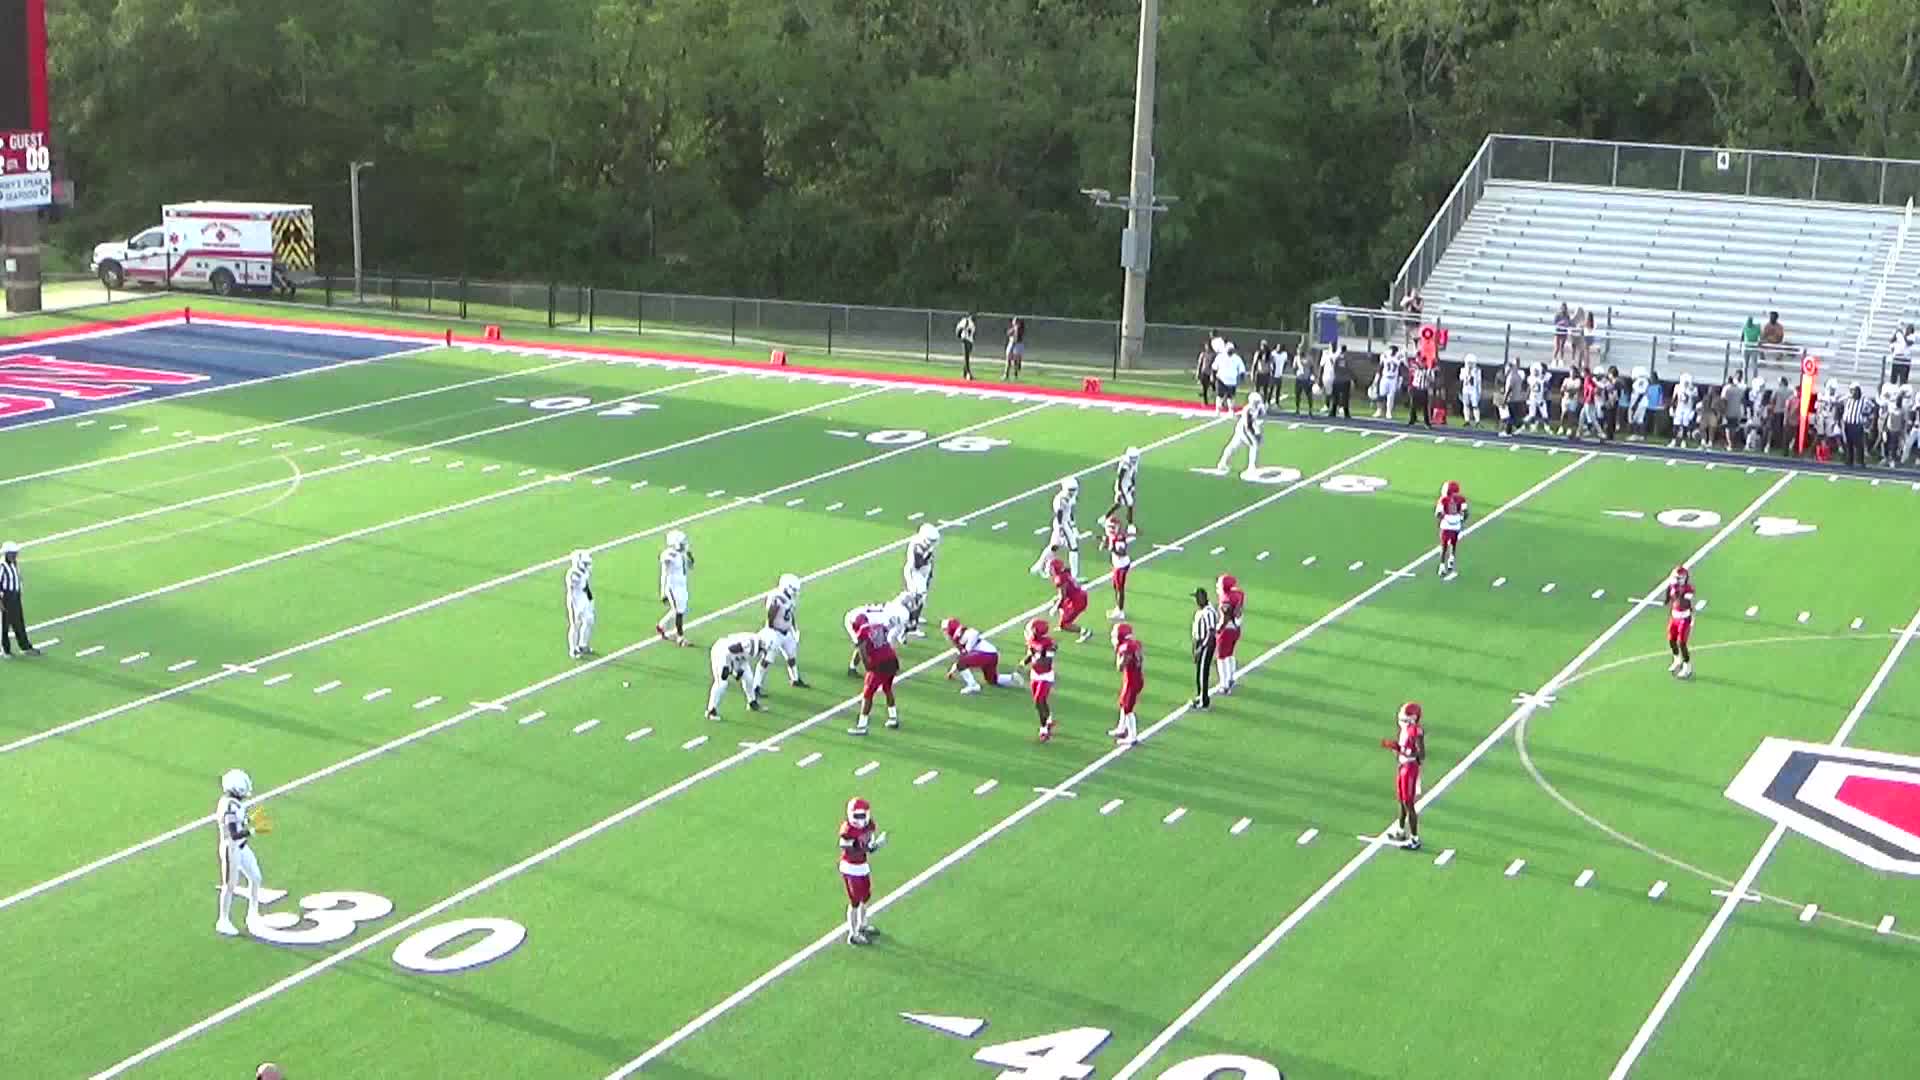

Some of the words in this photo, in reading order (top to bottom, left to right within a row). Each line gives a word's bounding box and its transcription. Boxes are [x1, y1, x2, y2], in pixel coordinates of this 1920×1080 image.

[9, 132, 44, 150] GUEST
[26, 146, 50, 172] 00
[245, 890, 528, 973] 30
